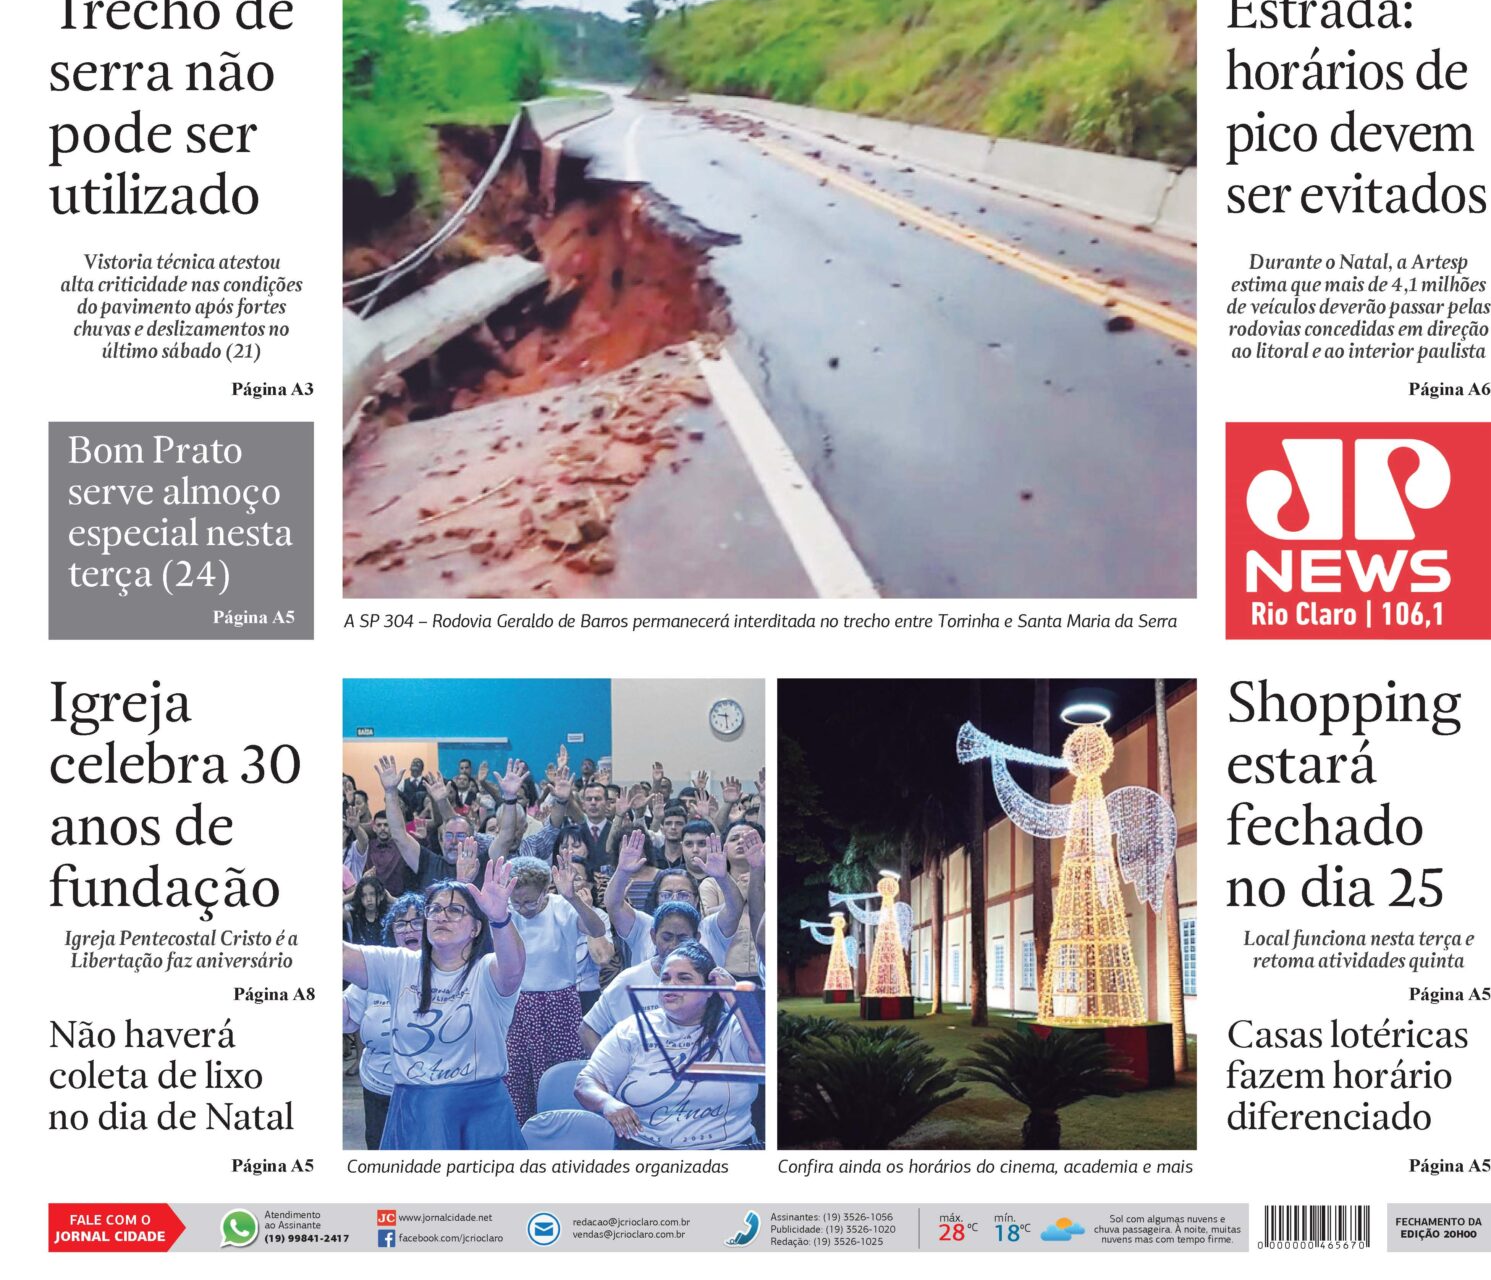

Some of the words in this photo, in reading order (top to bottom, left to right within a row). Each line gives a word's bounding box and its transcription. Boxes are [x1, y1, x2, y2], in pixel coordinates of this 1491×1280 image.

[50, 62, 173, 91] serra
[186, 51, 274, 91] não
[1226, 47, 1403, 90] horários
[1416, 48, 1467, 90] de
[49, 110, 171, 166] pode
[187, 124, 257, 153] ser
[1226, 111, 1317, 165] pico
[1331, 110, 1474, 152] devem
[49, 171, 258, 215] utilizado
[1227, 185, 1291, 213] ser
[1301, 171, 1486, 213] evitados
[69, 436, 144, 463] Bom
[154, 436, 242, 464] Prato
[69, 485, 153, 505] serve
[164, 476, 280, 514] almoço
[1246, 438, 1451, 541] JP
[69, 517, 198, 555] especial
[207, 522, 293, 546] nesta
[68, 563, 152, 596] terça
[163, 560, 229, 595] (24)
[1246, 549, 1452, 593] NEWS
[214, 610, 267, 627] Página
[272, 611, 294, 623] A5
[1251, 601, 1289, 625] Rio
[1296, 601, 1357, 625] Claro
[1382, 601, 1443, 628] 106,1
[51, 680, 192, 735] Igreja
[1229, 679, 1461, 735] Shopping
[51, 740, 228, 784] celebra
[241, 744, 300, 784] 30
[1228, 739, 1377, 784] estará
[51, 817, 160, 846] anos
[176, 802, 232, 845] de
[1227, 802, 1422, 846] fechado
[50, 863, 279, 921] fundação
[1227, 878, 1285, 907] no
[1302, 864, 1375, 907] dia
[1389, 868, 1443, 907] 25
[50, 1021, 115, 1048] Não
[125, 1018, 236, 1048] haverá
[50, 1060, 148, 1089] coleta
[158, 1060, 196, 1089] de
[205, 1060, 262, 1089] lixo
[49, 1111, 88, 1130] no
[99, 1101, 148, 1130] dia
[158, 1101, 196, 1130] de
[206, 1101, 294, 1130] Natal
[348, 1159, 441, 1173] Comunidade
[447, 1160, 514, 1177] participa
[520, 1159, 546, 1173] das
[552, 1159, 630, 1173] atividades
[636, 1159, 728, 1177] organizadas
[54, 1231, 110, 1243] JORNAL
[114, 1231, 165, 1242] CIDADE
[69, 1215, 102, 1225] FALE
[106, 1215, 138, 1225] COM
[141, 1215, 151, 1225] O
[399, 1214, 492, 1223] www.jornalcidade.net
[573, 1218, 690, 1228] redacao@jcrioclaro.com.br
[573, 1230, 685, 1240] vendas@jcrioclaro.com.br
[939, 1224, 965, 1241] 28
[995, 1224, 1020, 1242] 18
[264, 1234, 285, 1244] (19)
[288, 1234, 349, 1244] 99841-2417
[399, 1234, 503, 1244] facebook.com/jcrioclaro
